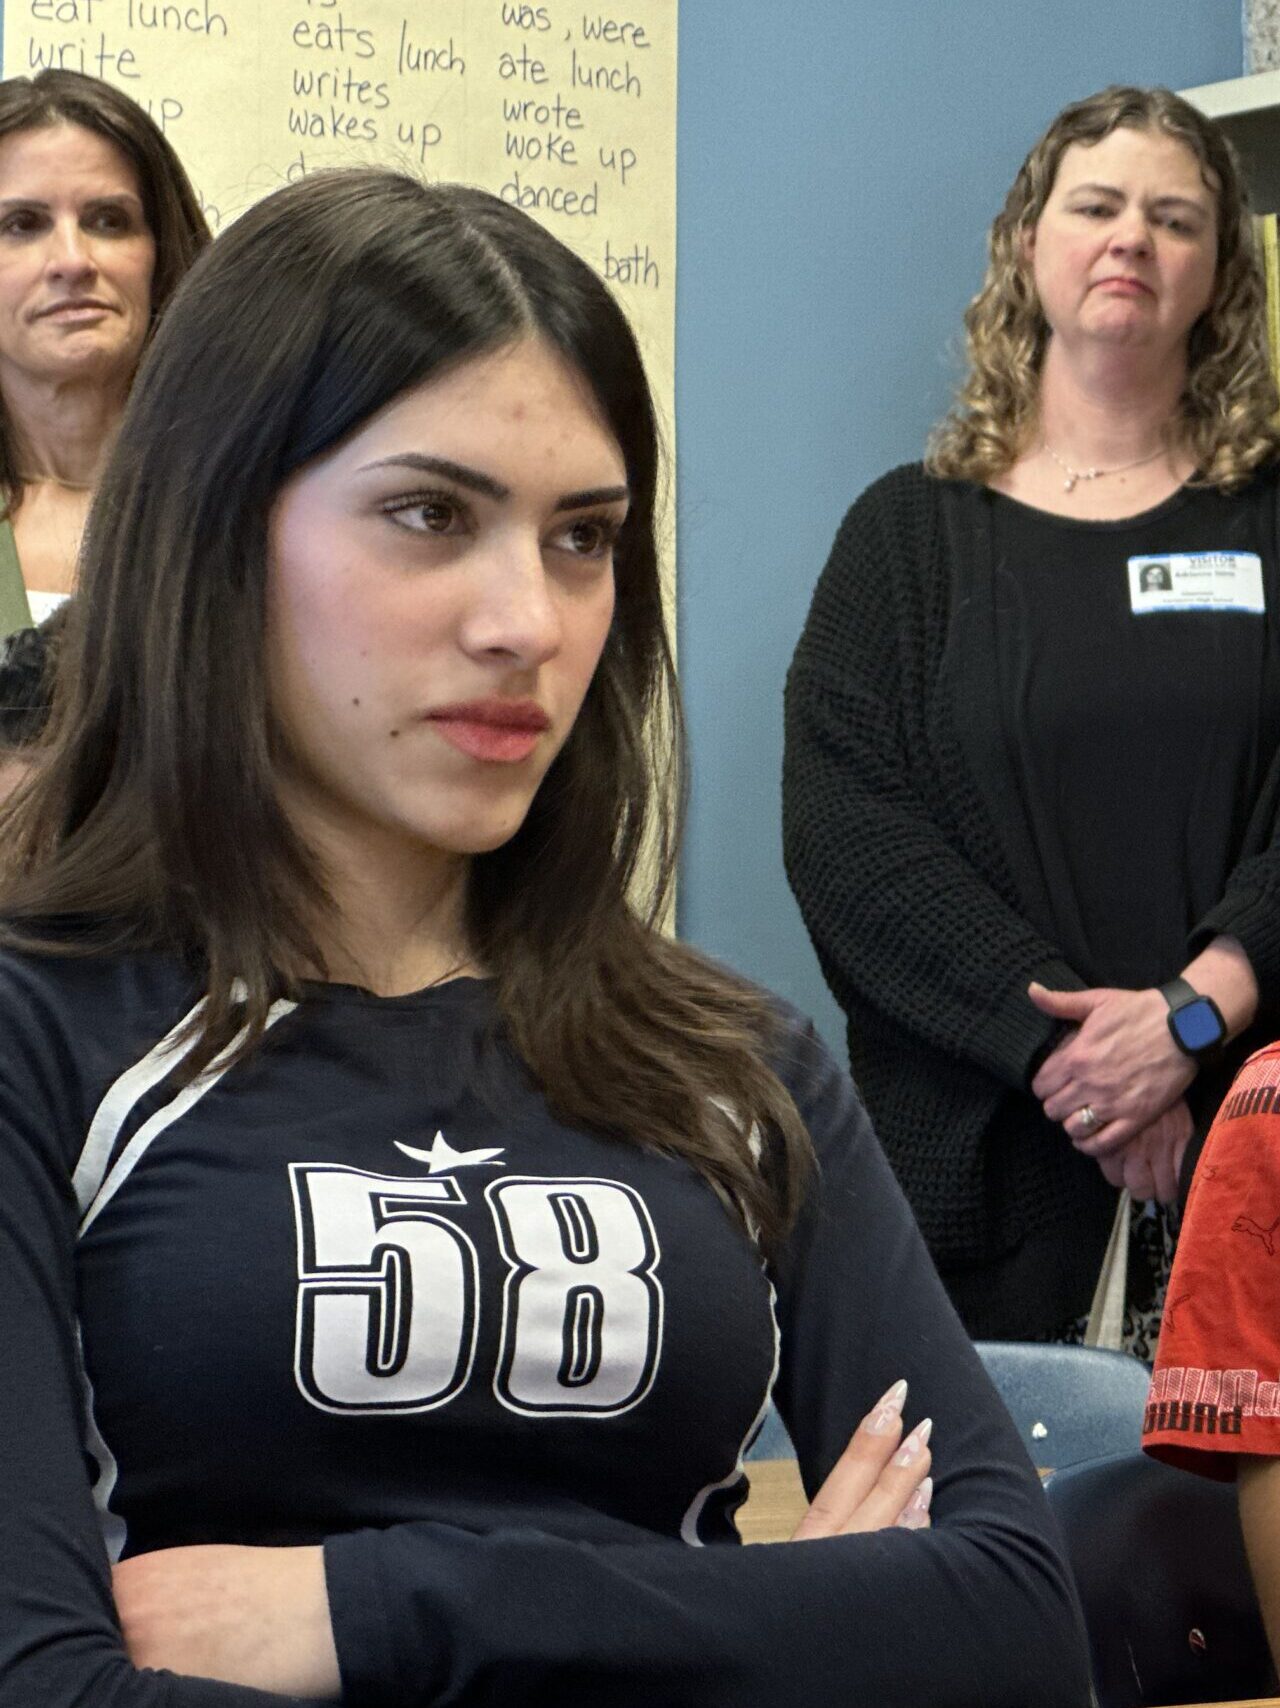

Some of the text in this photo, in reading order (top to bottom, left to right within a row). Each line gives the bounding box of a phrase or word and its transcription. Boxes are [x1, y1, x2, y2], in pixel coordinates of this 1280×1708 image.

[128, 0, 228, 36] lunch
[502, 2, 551, 31] was
[583, 15, 651, 48] were
[29, 33, 141, 79] write
[292, 13, 466, 75] eats lunch
[293, 66, 390, 109] writes
[499, 43, 641, 98] ate lunch
[289, 104, 442, 163] wakes up
[503, 93, 584, 129] wrote
[506, 130, 637, 185] woke up
[500, 171, 597, 216] danced
[604, 240, 660, 288] bath
[288, 1162, 664, 1418] 58
